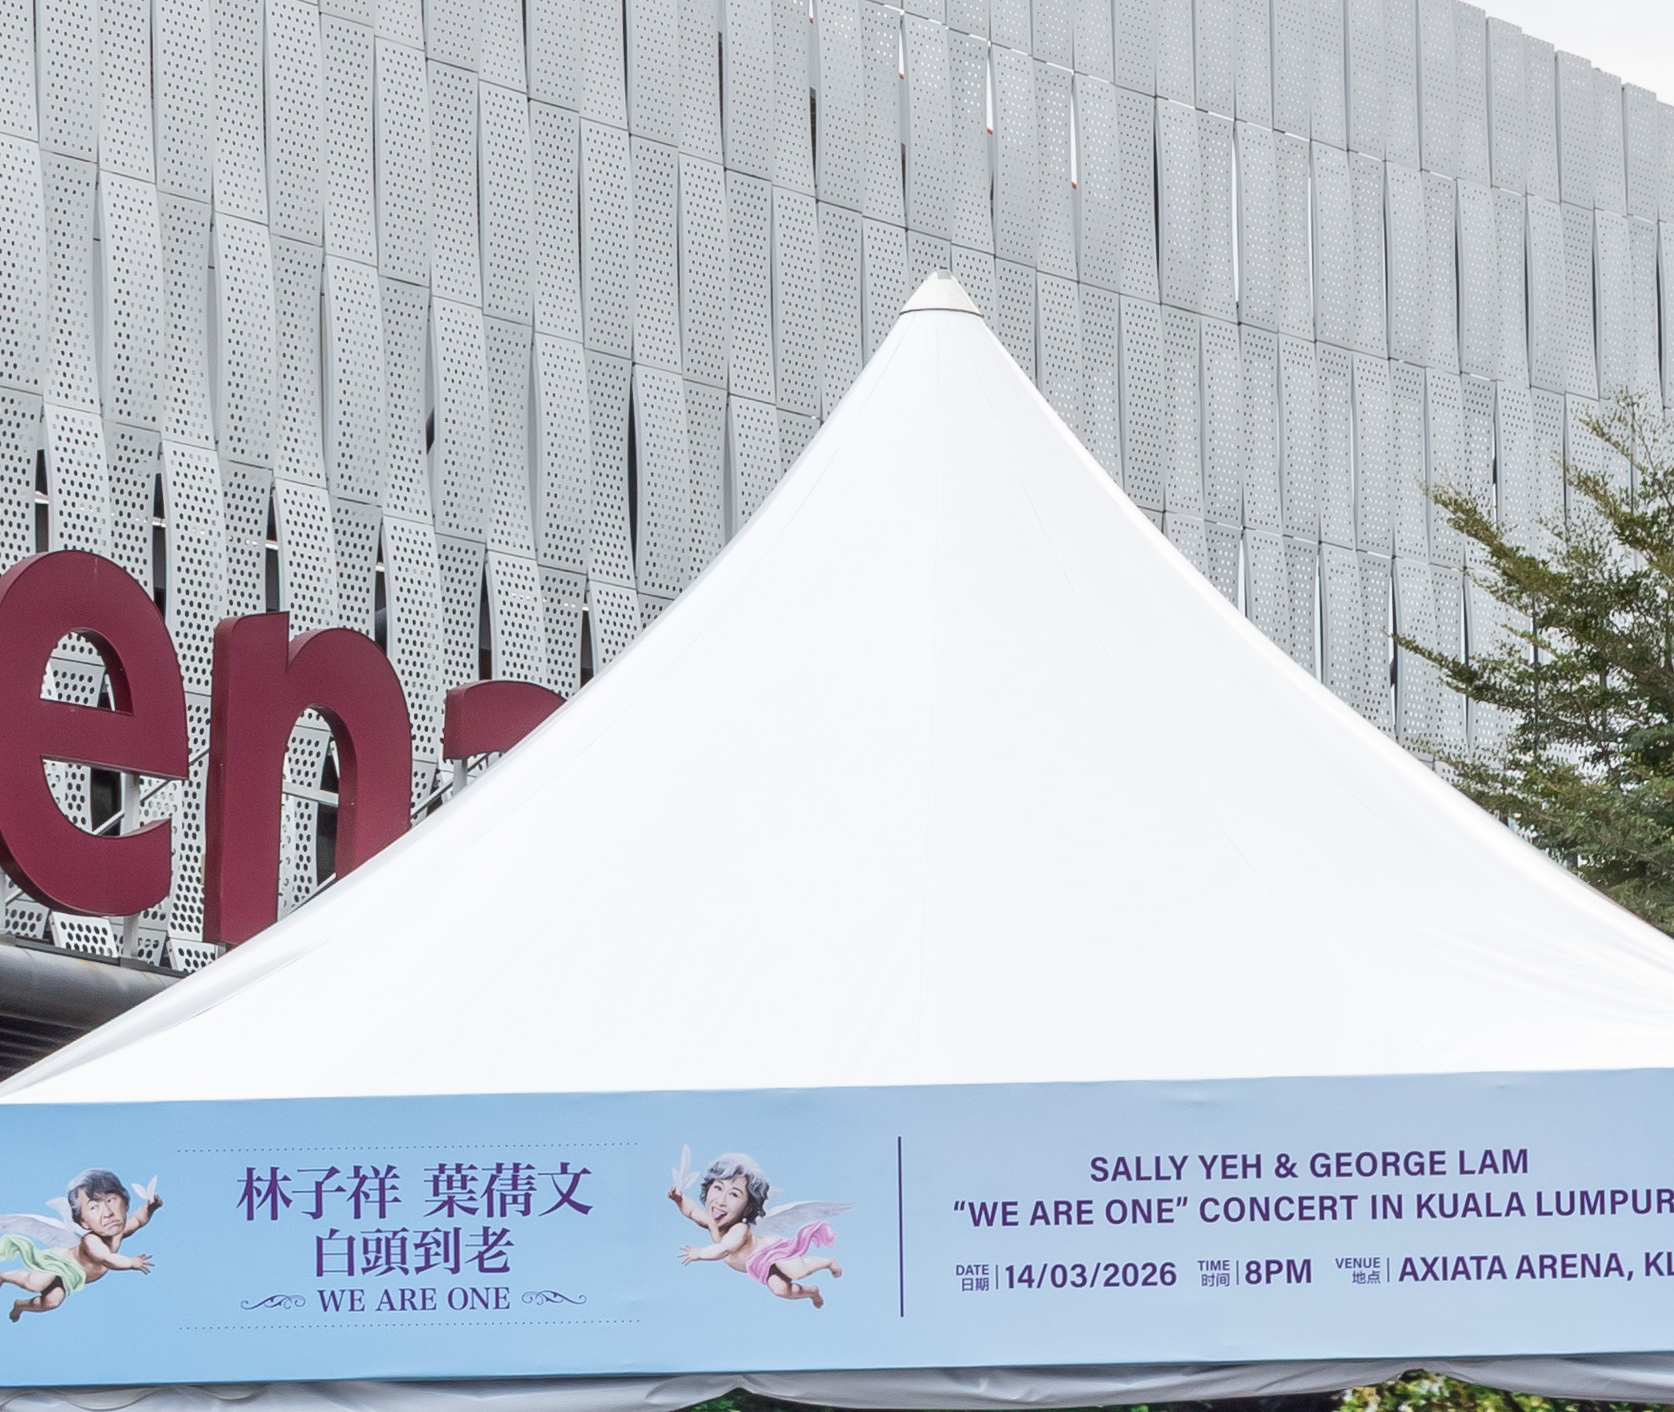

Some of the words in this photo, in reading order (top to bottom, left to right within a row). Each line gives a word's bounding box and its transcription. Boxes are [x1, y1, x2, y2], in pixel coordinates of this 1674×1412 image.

[1090, 1155, 1189, 1183] SALLY
[1198, 1153, 1263, 1180] YEH
[1274, 1152, 1299, 1179] &
[1309, 1150, 1447, 1178] GEORGE
[1458, 1148, 1529, 1175] LAM
[237, 1165, 402, 1221] 林子祥
[424, 1162, 594, 1219] 葉蒨文
[1029, 1200, 1094, 1226] ARE
[1199, 1195, 1359, 1223] CONCERT
[1371, 1194, 1403, 1220] IN
[1416, 1191, 1527, 1219] KUALA
[315, 1226, 515, 1277] 白頭到老
[955, 1263, 990, 1277] DATE
[1005, 1261, 1177, 1289] 14/03/2026
[1197, 1259, 1231, 1272] TIME
[1244, 1258, 1312, 1285] 8PM
[1335, 1257, 1381, 1270] VENUE
[1398, 1255, 1507, 1282] AXIATA
[1515, 1253, 1634, 1282] ARENA,
[961, 1277, 990, 1292] 日期
[1201, 1272, 1231, 1288] 时间
[1352, 1271, 1381, 1285] 地点
[317, 1288, 366, 1312] WE
[375, 1287, 437, 1312] ARE
[447, 1286, 511, 1311] ONE
